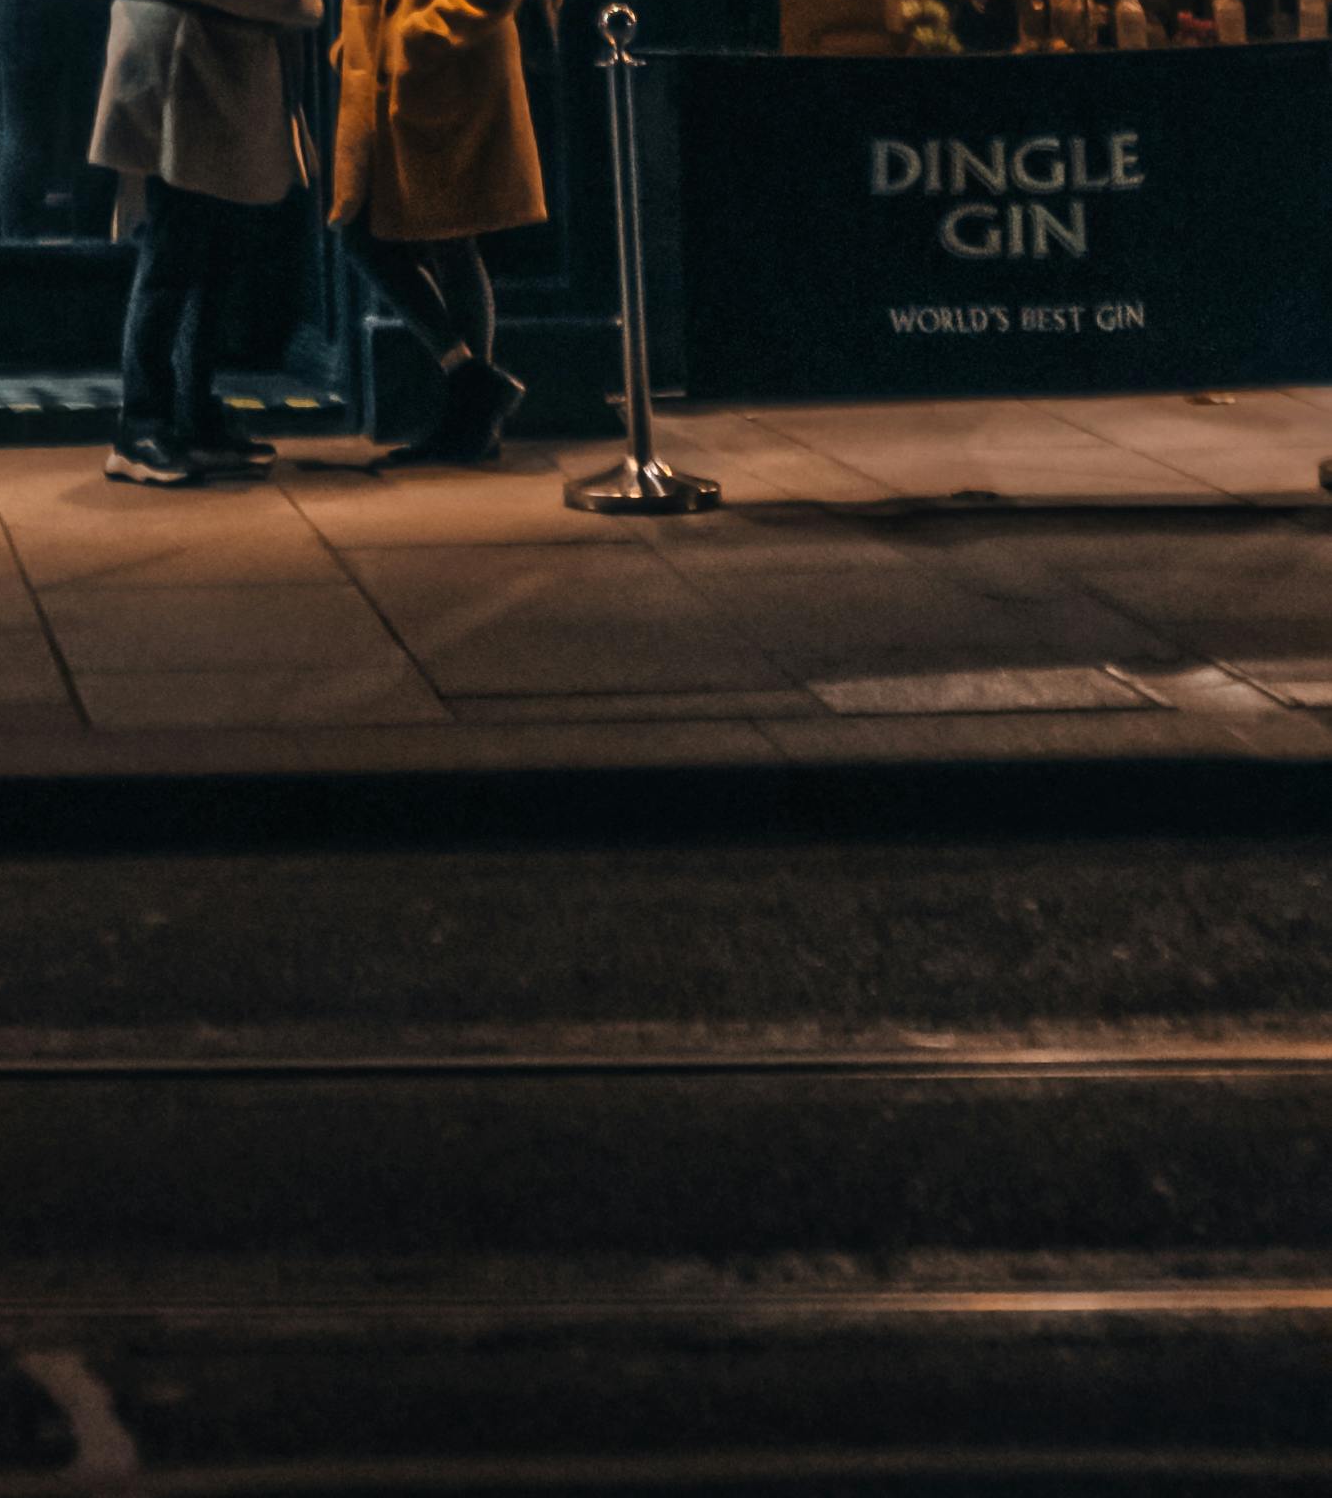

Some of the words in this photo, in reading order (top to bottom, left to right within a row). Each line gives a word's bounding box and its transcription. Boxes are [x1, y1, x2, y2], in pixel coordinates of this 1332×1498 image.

[868, 129, 1148, 197] DINGLE
[938, 201, 1091, 261] GIN
[887, 305, 1011, 335] WORLD'S
[1021, 304, 1083, 334] BEST
[1095, 302, 1147, 331] GIN
